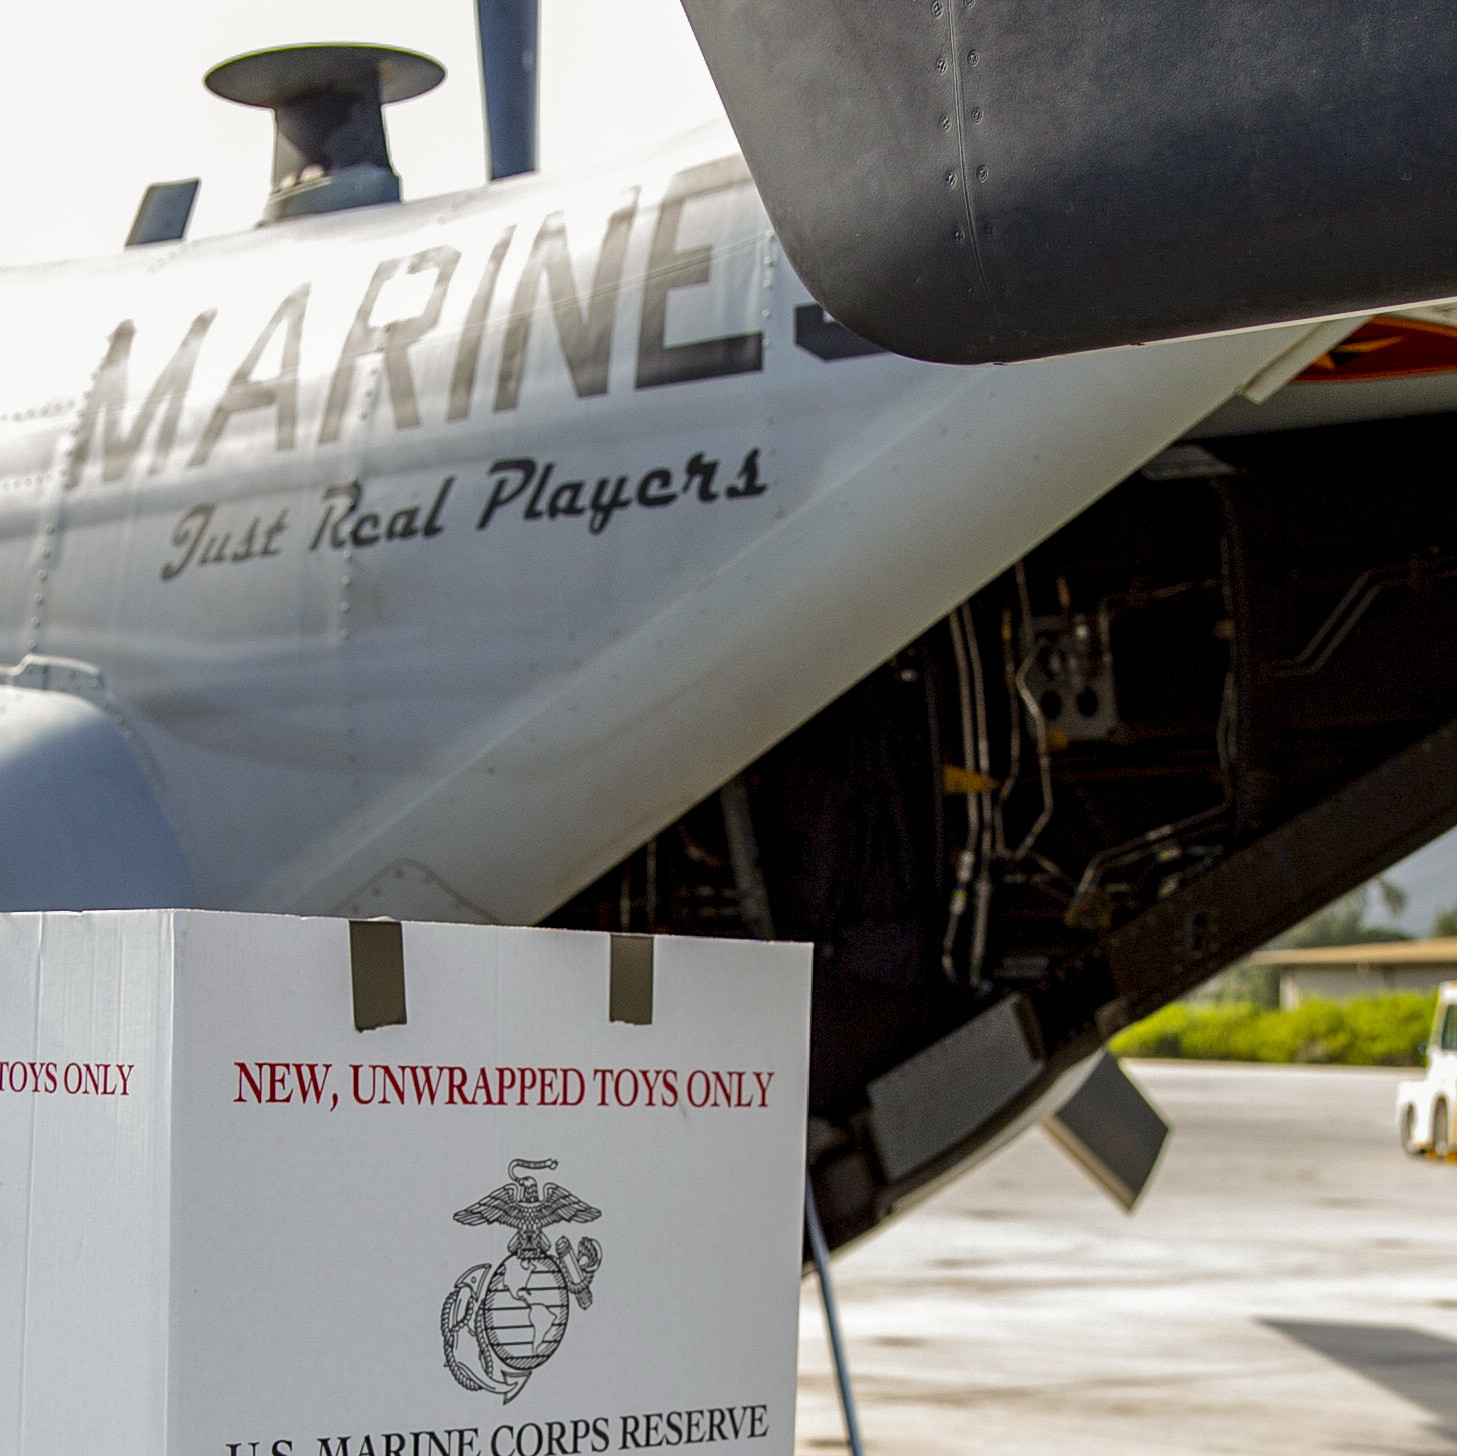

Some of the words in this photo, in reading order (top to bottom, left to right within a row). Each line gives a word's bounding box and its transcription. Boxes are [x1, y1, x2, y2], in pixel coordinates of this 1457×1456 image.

[62, 153, 889, 492] MARINE
[159, 503, 290, 582] Just
[310, 475, 456, 554] Real
[476, 444, 769, 532] Players
[63, 1063, 135, 1096] ONLY
[233, 1061, 338, 1112] NEW,
[349, 1063, 585, 1107] UNWRAPPED
[593, 1068, 679, 1107] TOYS
[687, 1070, 775, 1108] ONLY
[618, 1404, 769, 1450] RESERVE
